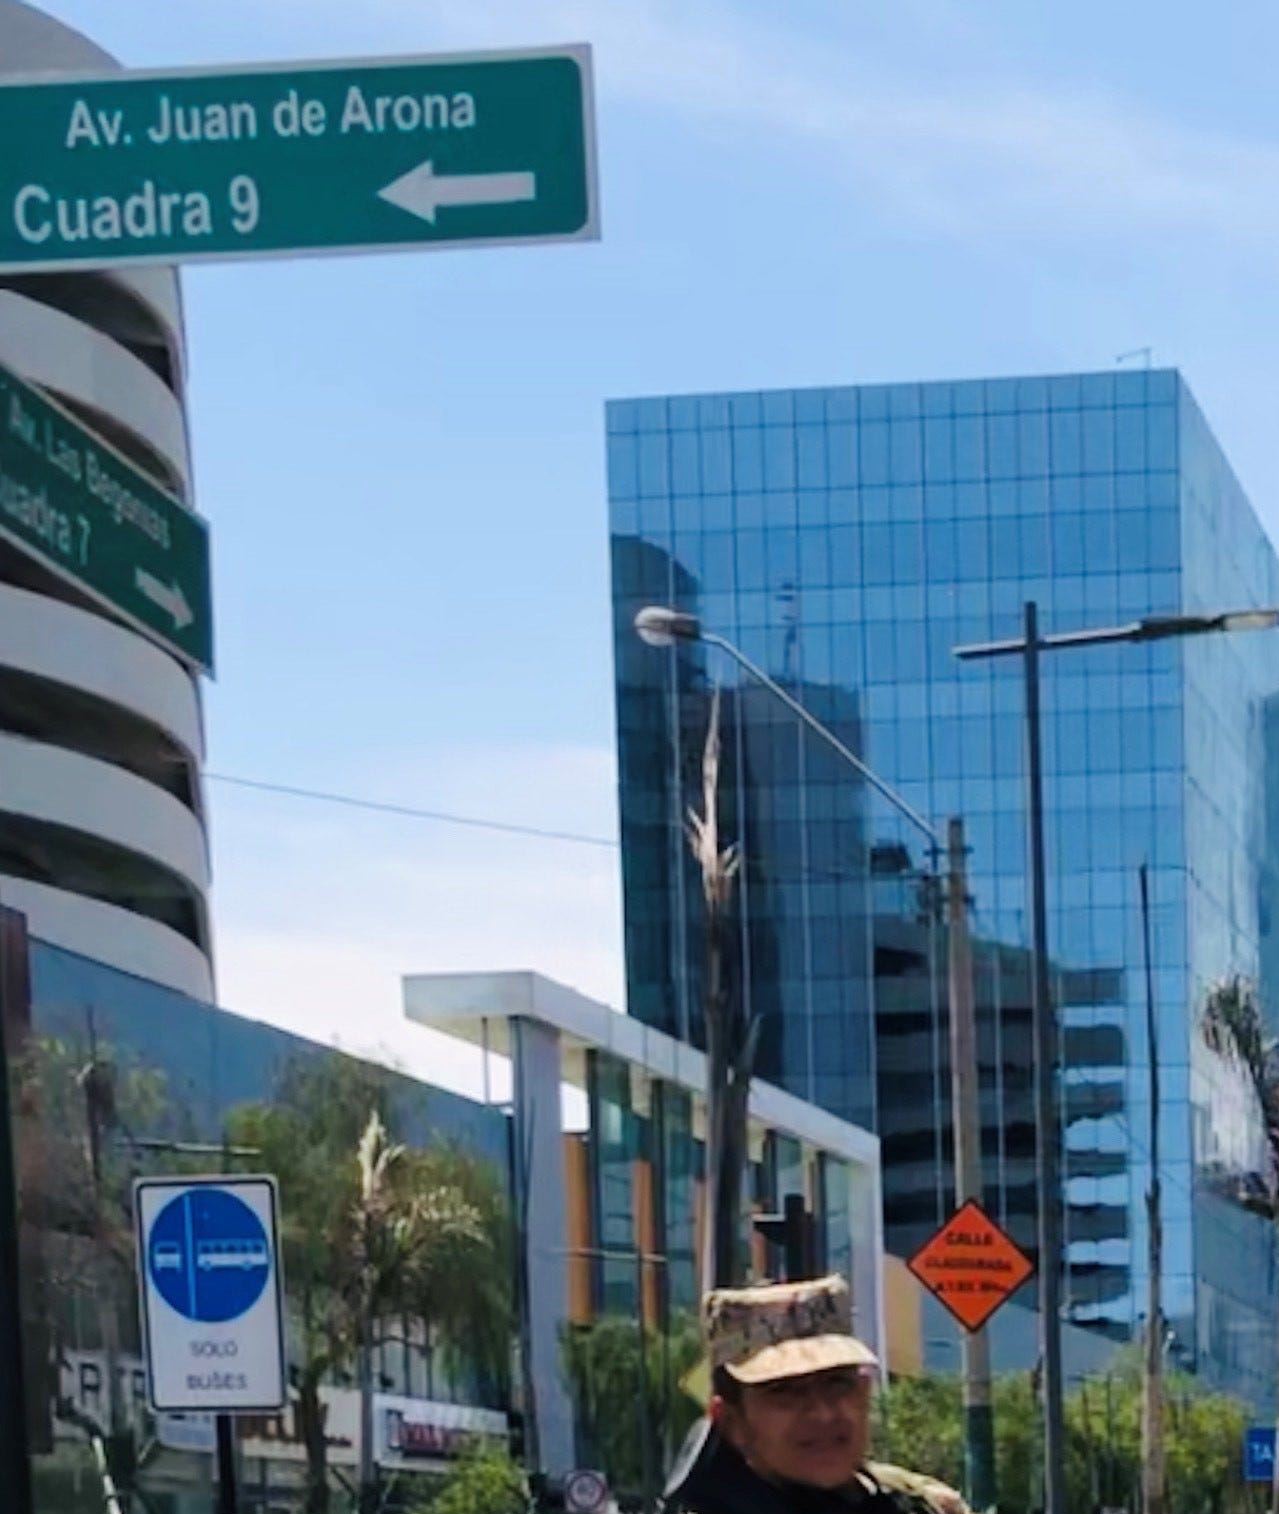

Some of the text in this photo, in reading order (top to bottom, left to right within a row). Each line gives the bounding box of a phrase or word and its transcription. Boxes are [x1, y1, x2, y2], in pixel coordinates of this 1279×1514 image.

[65, 85, 476, 149] Av. Juan de Arona
[14, 174, 260, 244] Cuadra 9
[0, 473, 73, 556] uadra
[189, 1339, 239, 1358] SOLO
[186, 1372, 248, 1390] BUSES
